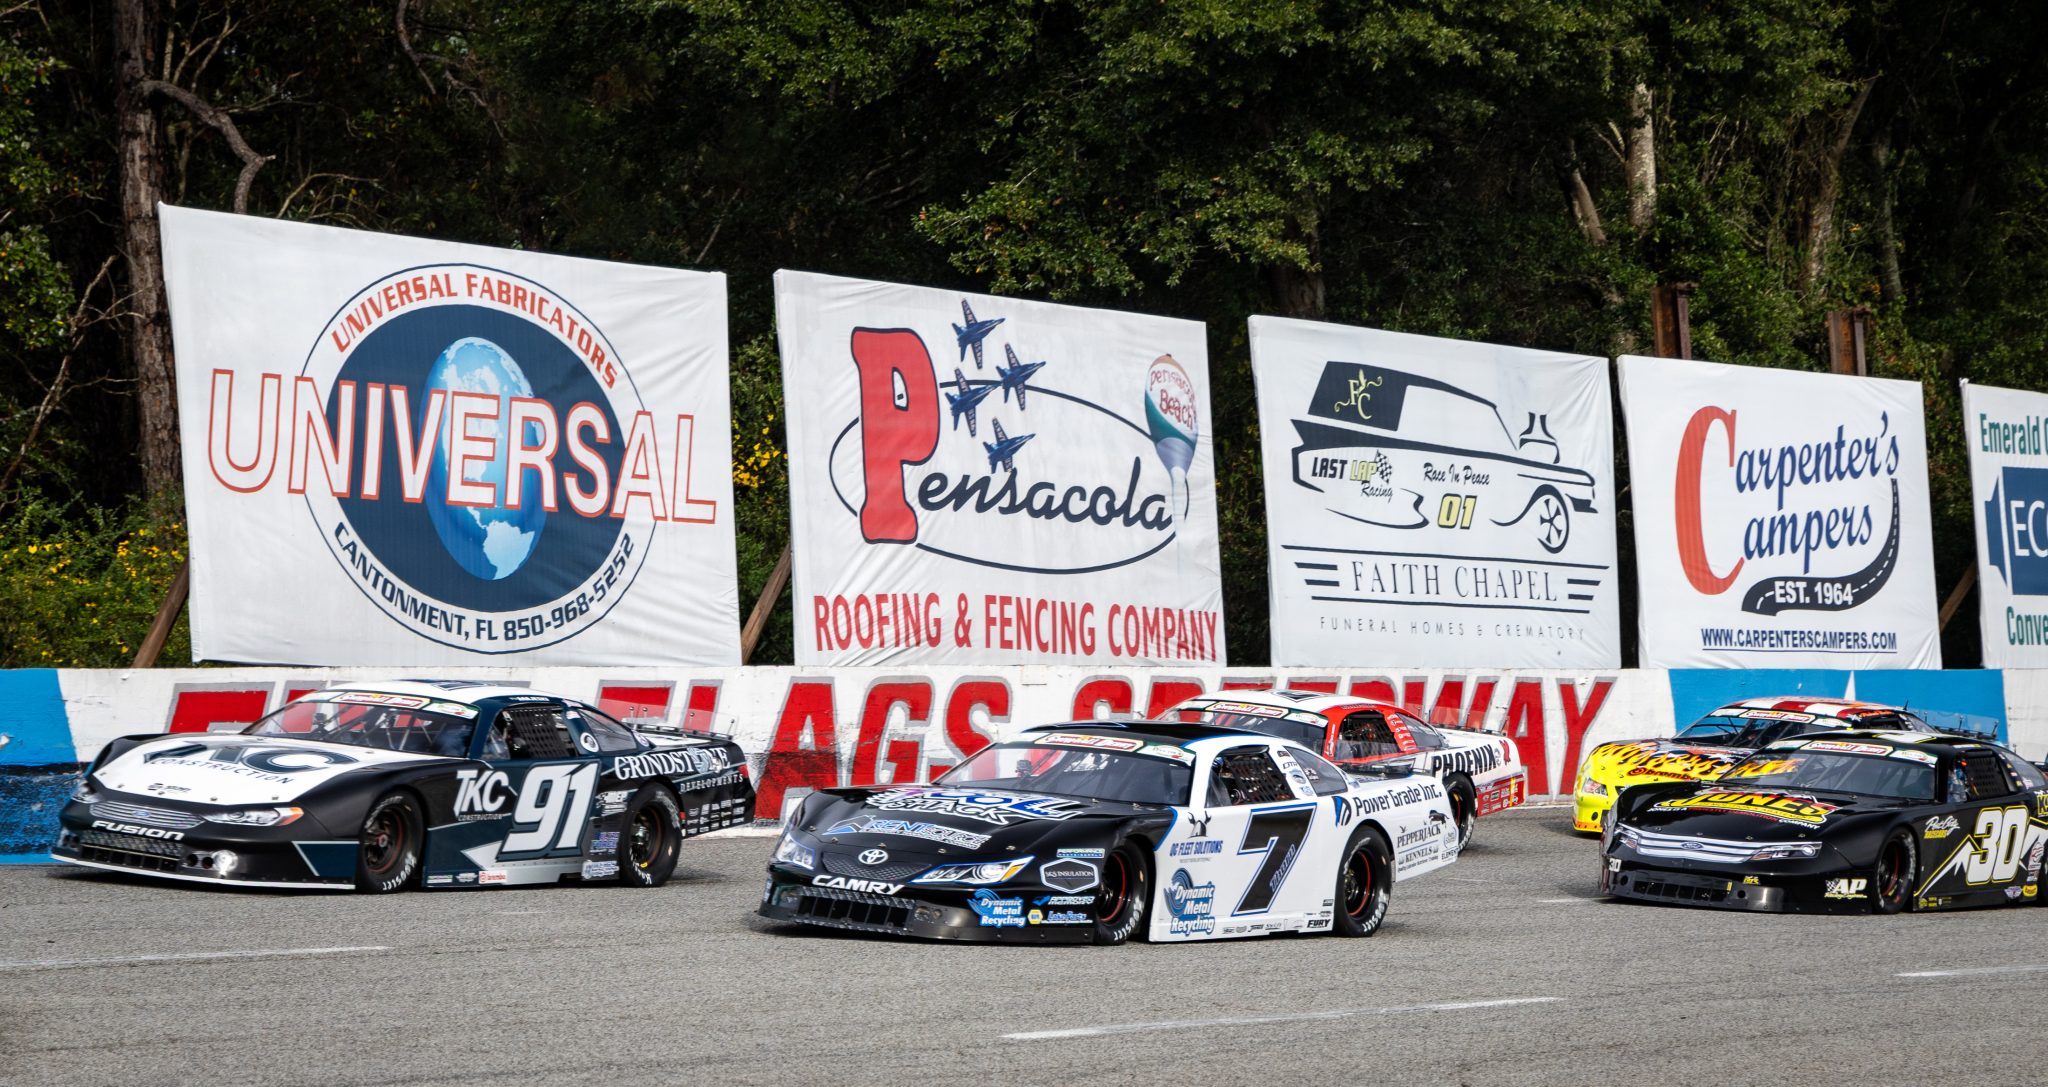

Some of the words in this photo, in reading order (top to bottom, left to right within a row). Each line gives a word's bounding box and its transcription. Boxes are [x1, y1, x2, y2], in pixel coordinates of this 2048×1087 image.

[332, 273, 458, 353] UNIVERSAL
[466, 273, 618, 389] FABRICATORS
[1980, 413, 2041, 455] Emerald
[208, 369, 716, 524] UNIVERSAL
[1311, 457, 1348, 480] LAST
[1349, 459, 1377, 482] LAP
[1423, 462, 1447, 484] Race
[1449, 464, 1460, 484] In
[1463, 464, 1490, 485] Peace
[1361, 479, 1393, 502] Racing
[1437, 493, 1478, 530] 01
[334, 522, 469, 641] CANTONMENT,
[477, 620, 498, 641] FL
[504, 533, 634, 641] 850-968-5252
[1351, 561, 1440, 596] FAITH
[1454, 565, 1557, 602] CHAPEL
[1774, 581, 1810, 604] EST.
[1814, 582, 1853, 607] 1964
[814, 592, 941, 651] ROOFING
[954, 592, 971, 648] &
[984, 594, 1096, 656] FENCING
[1108, 603, 1217, 662] COMPANY
[1320, 616, 1398, 634] FUNERAL
[1410, 620, 1465, 636] HOMES
[1495, 623, 1585, 641] CREMATORY
[1701, 627, 1897, 651] WWW.CARPENTERSCAMPERS.COM
[151, 757, 294, 784] CONSTRUCTION
[1432, 744, 1497, 778] PHOENIX
[680, 774, 744, 793] DEVELOPMENTS
[1646, 769, 1700, 781] bremb
[453, 769, 509, 817] TKC
[1352, 794, 1390, 816] Power
[1387, 786, 1423, 807] Grade
[1418, 783, 1442, 800] Inc.
[1661, 792, 1838, 816] JONES
[502, 762, 599, 853] 91
[92, 820, 184, 840] FUSION
[1397, 823, 1441, 848] PEPPERJACK
[1778, 818, 1821, 830] COMPANY
[1966, 805, 2029, 886] 30
[1232, 804, 1317, 916] 7
[1609, 858, 1621, 871] 30
[812, 874, 905, 895] CAMRY
[1176, 884, 1214, 904] Dynamic
[1834, 878, 1868, 894] AP
[981, 895, 1022, 907] Dynamic
[993, 906, 1021, 915] Metal
[1184, 900, 1212, 914] Metal
[981, 915, 1026, 928] Recycling
[1171, 917, 1215, 935] Recycling
[1306, 918, 1332, 928] FURY
